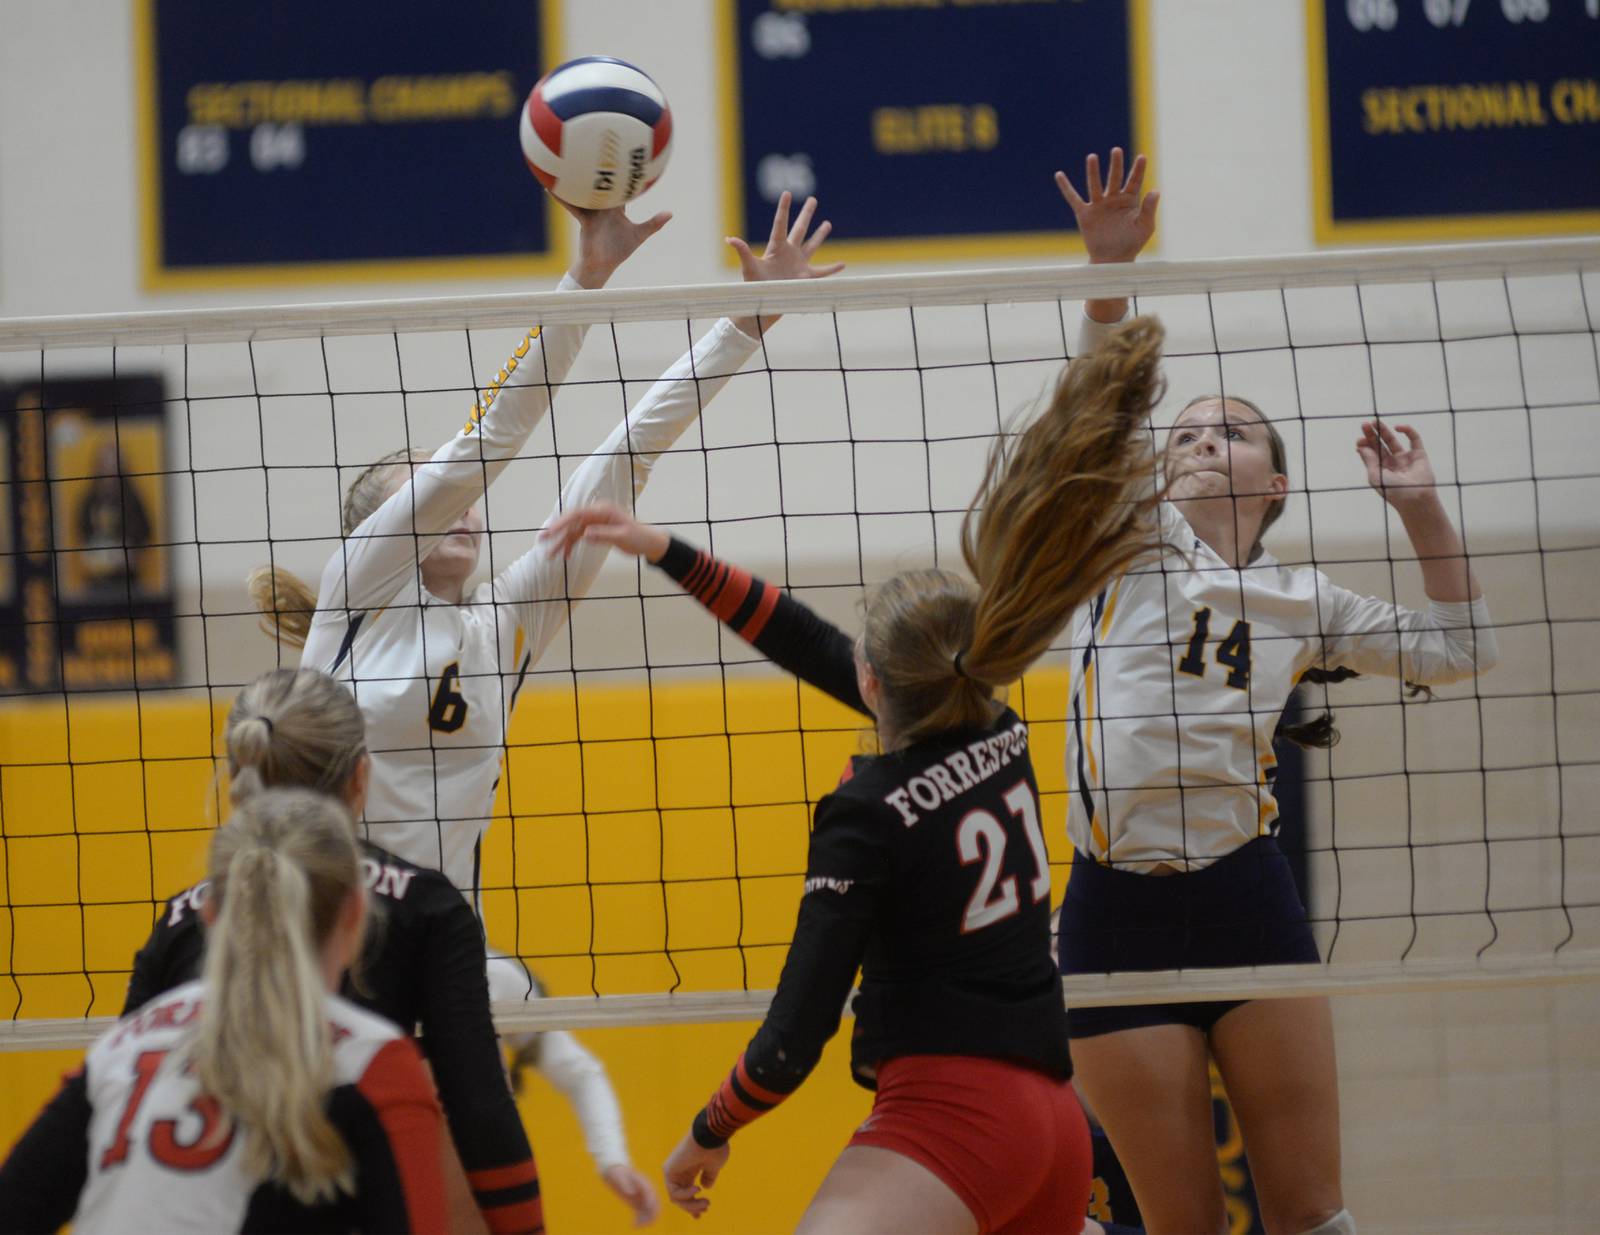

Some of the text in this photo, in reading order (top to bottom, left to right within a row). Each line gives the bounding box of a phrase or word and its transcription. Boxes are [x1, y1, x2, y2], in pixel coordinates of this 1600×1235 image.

[1363, 82, 1547, 133] SECTIONAL
[1178, 606, 1250, 691] 14
[427, 661, 468, 734] 6
[885, 722, 1028, 828] FORRESTO
[956, 777, 1050, 935] 21
[99, 1050, 238, 1170] 13
